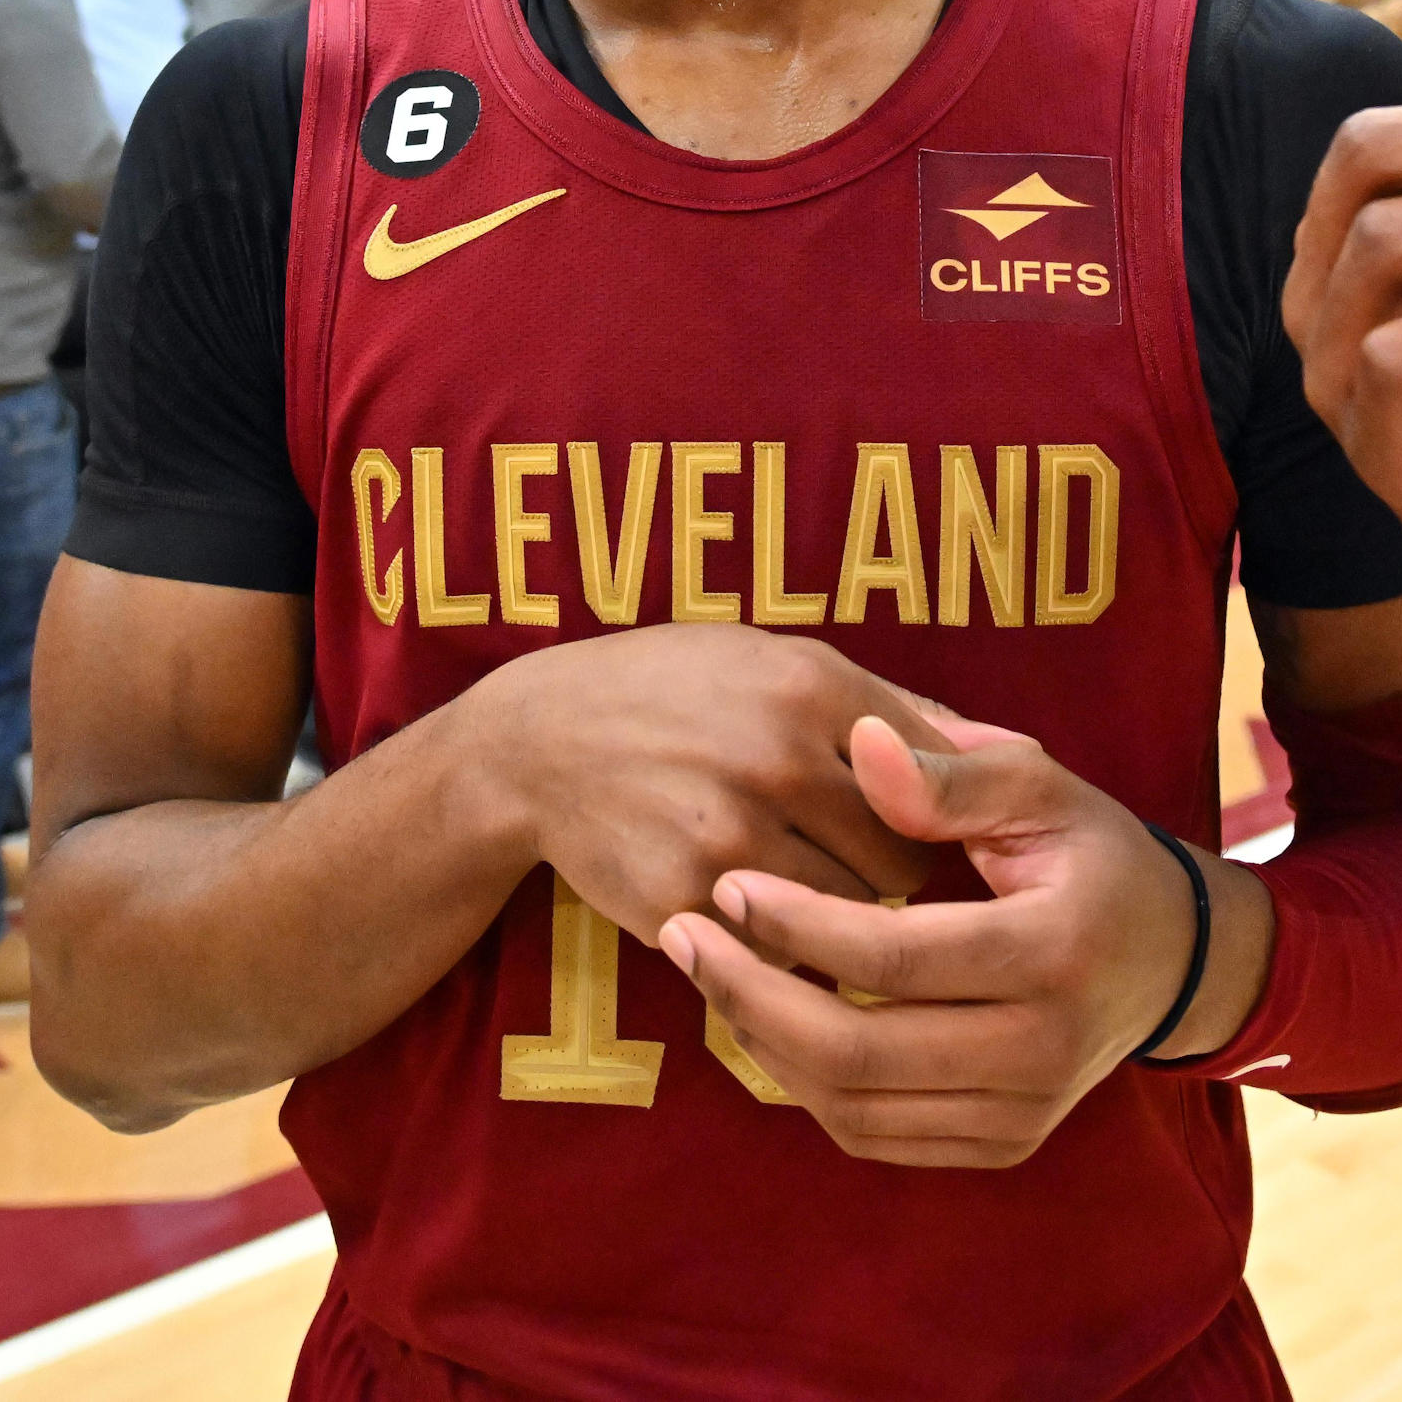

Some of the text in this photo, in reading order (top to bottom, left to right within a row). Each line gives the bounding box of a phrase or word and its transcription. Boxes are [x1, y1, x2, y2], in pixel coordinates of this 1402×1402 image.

[386, 85, 454, 163] 6
[930, 258, 1111, 297] CLIFFS
[350, 441, 1121, 628] CLEVELAND
